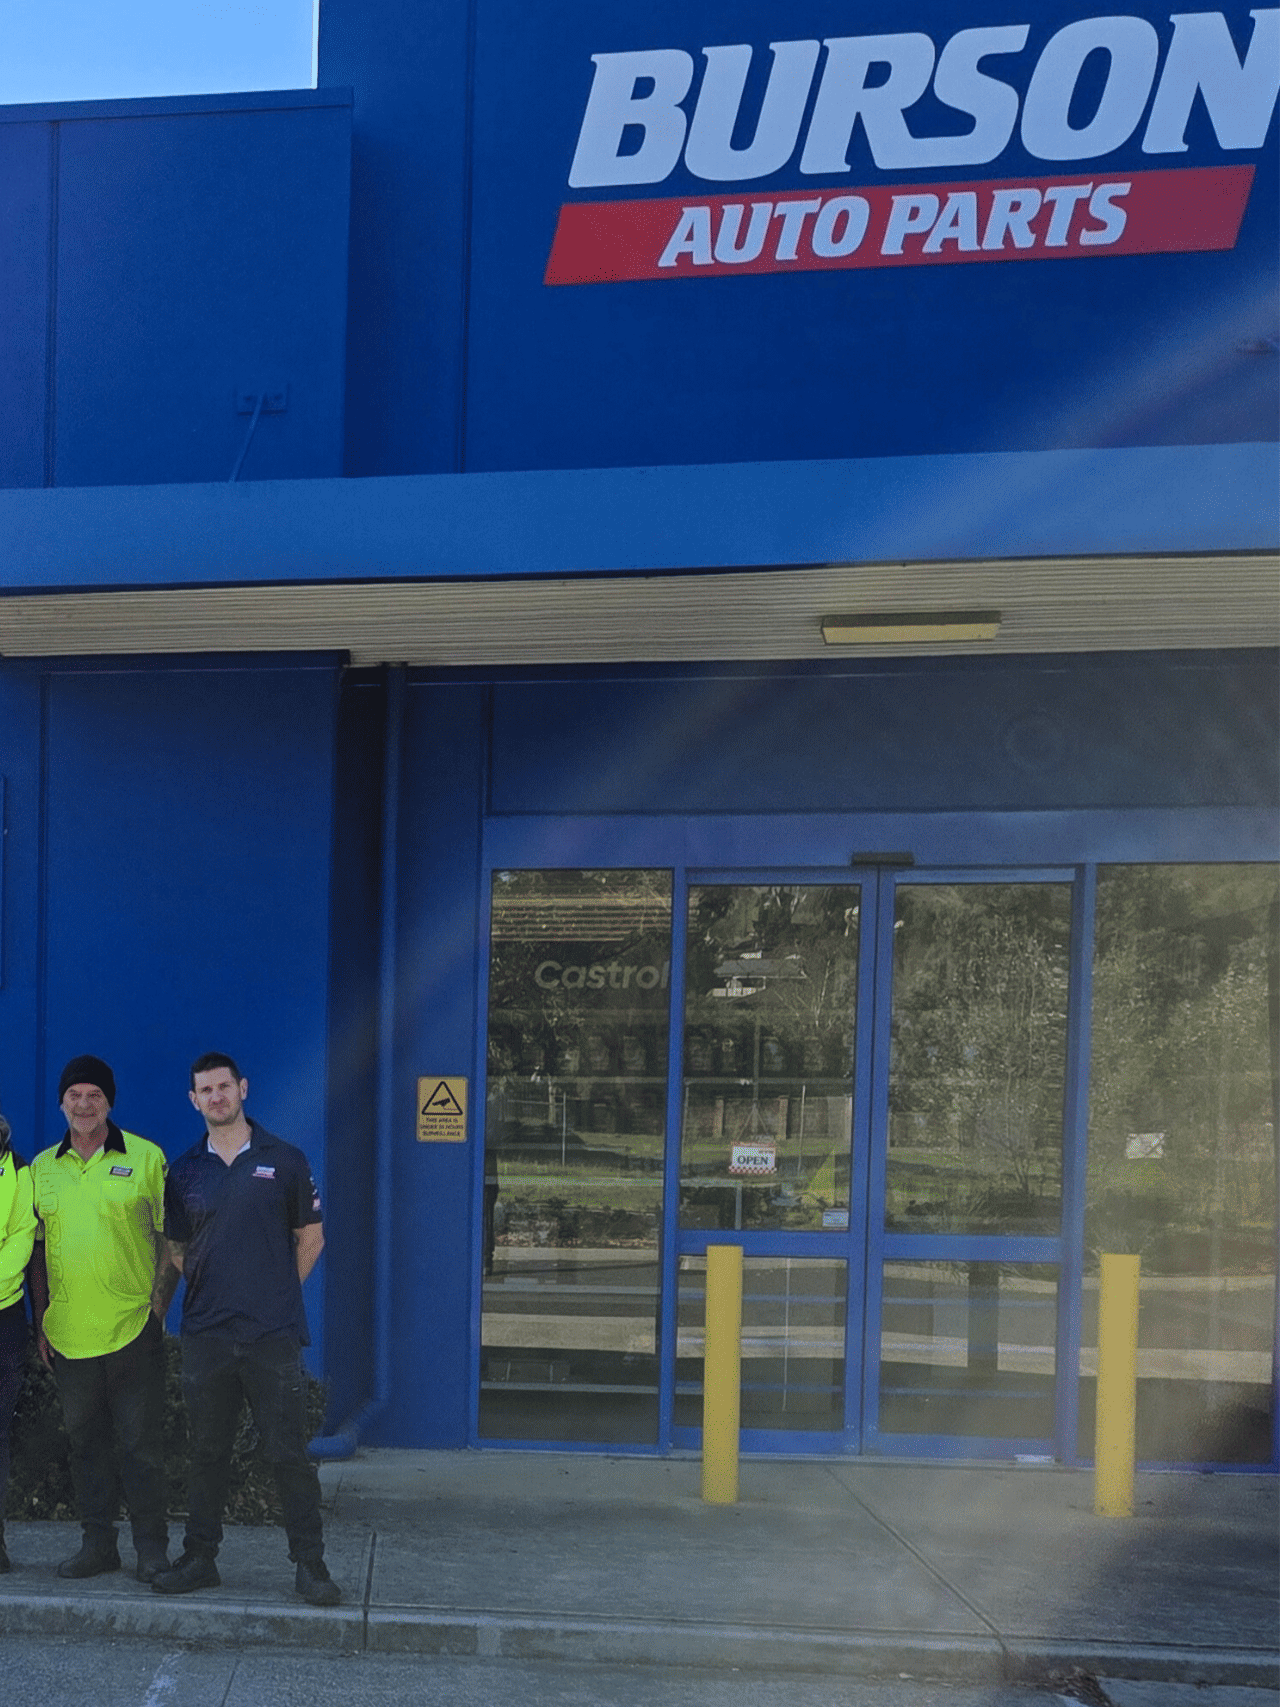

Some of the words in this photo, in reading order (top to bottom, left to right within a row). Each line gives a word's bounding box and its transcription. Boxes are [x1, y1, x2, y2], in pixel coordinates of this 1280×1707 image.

[568, 8, 1280, 188] BURSON
[657, 195, 871, 268] AUTO
[881, 182, 1132, 256] PARTS
[737, 1155, 769, 1165] OPEN
